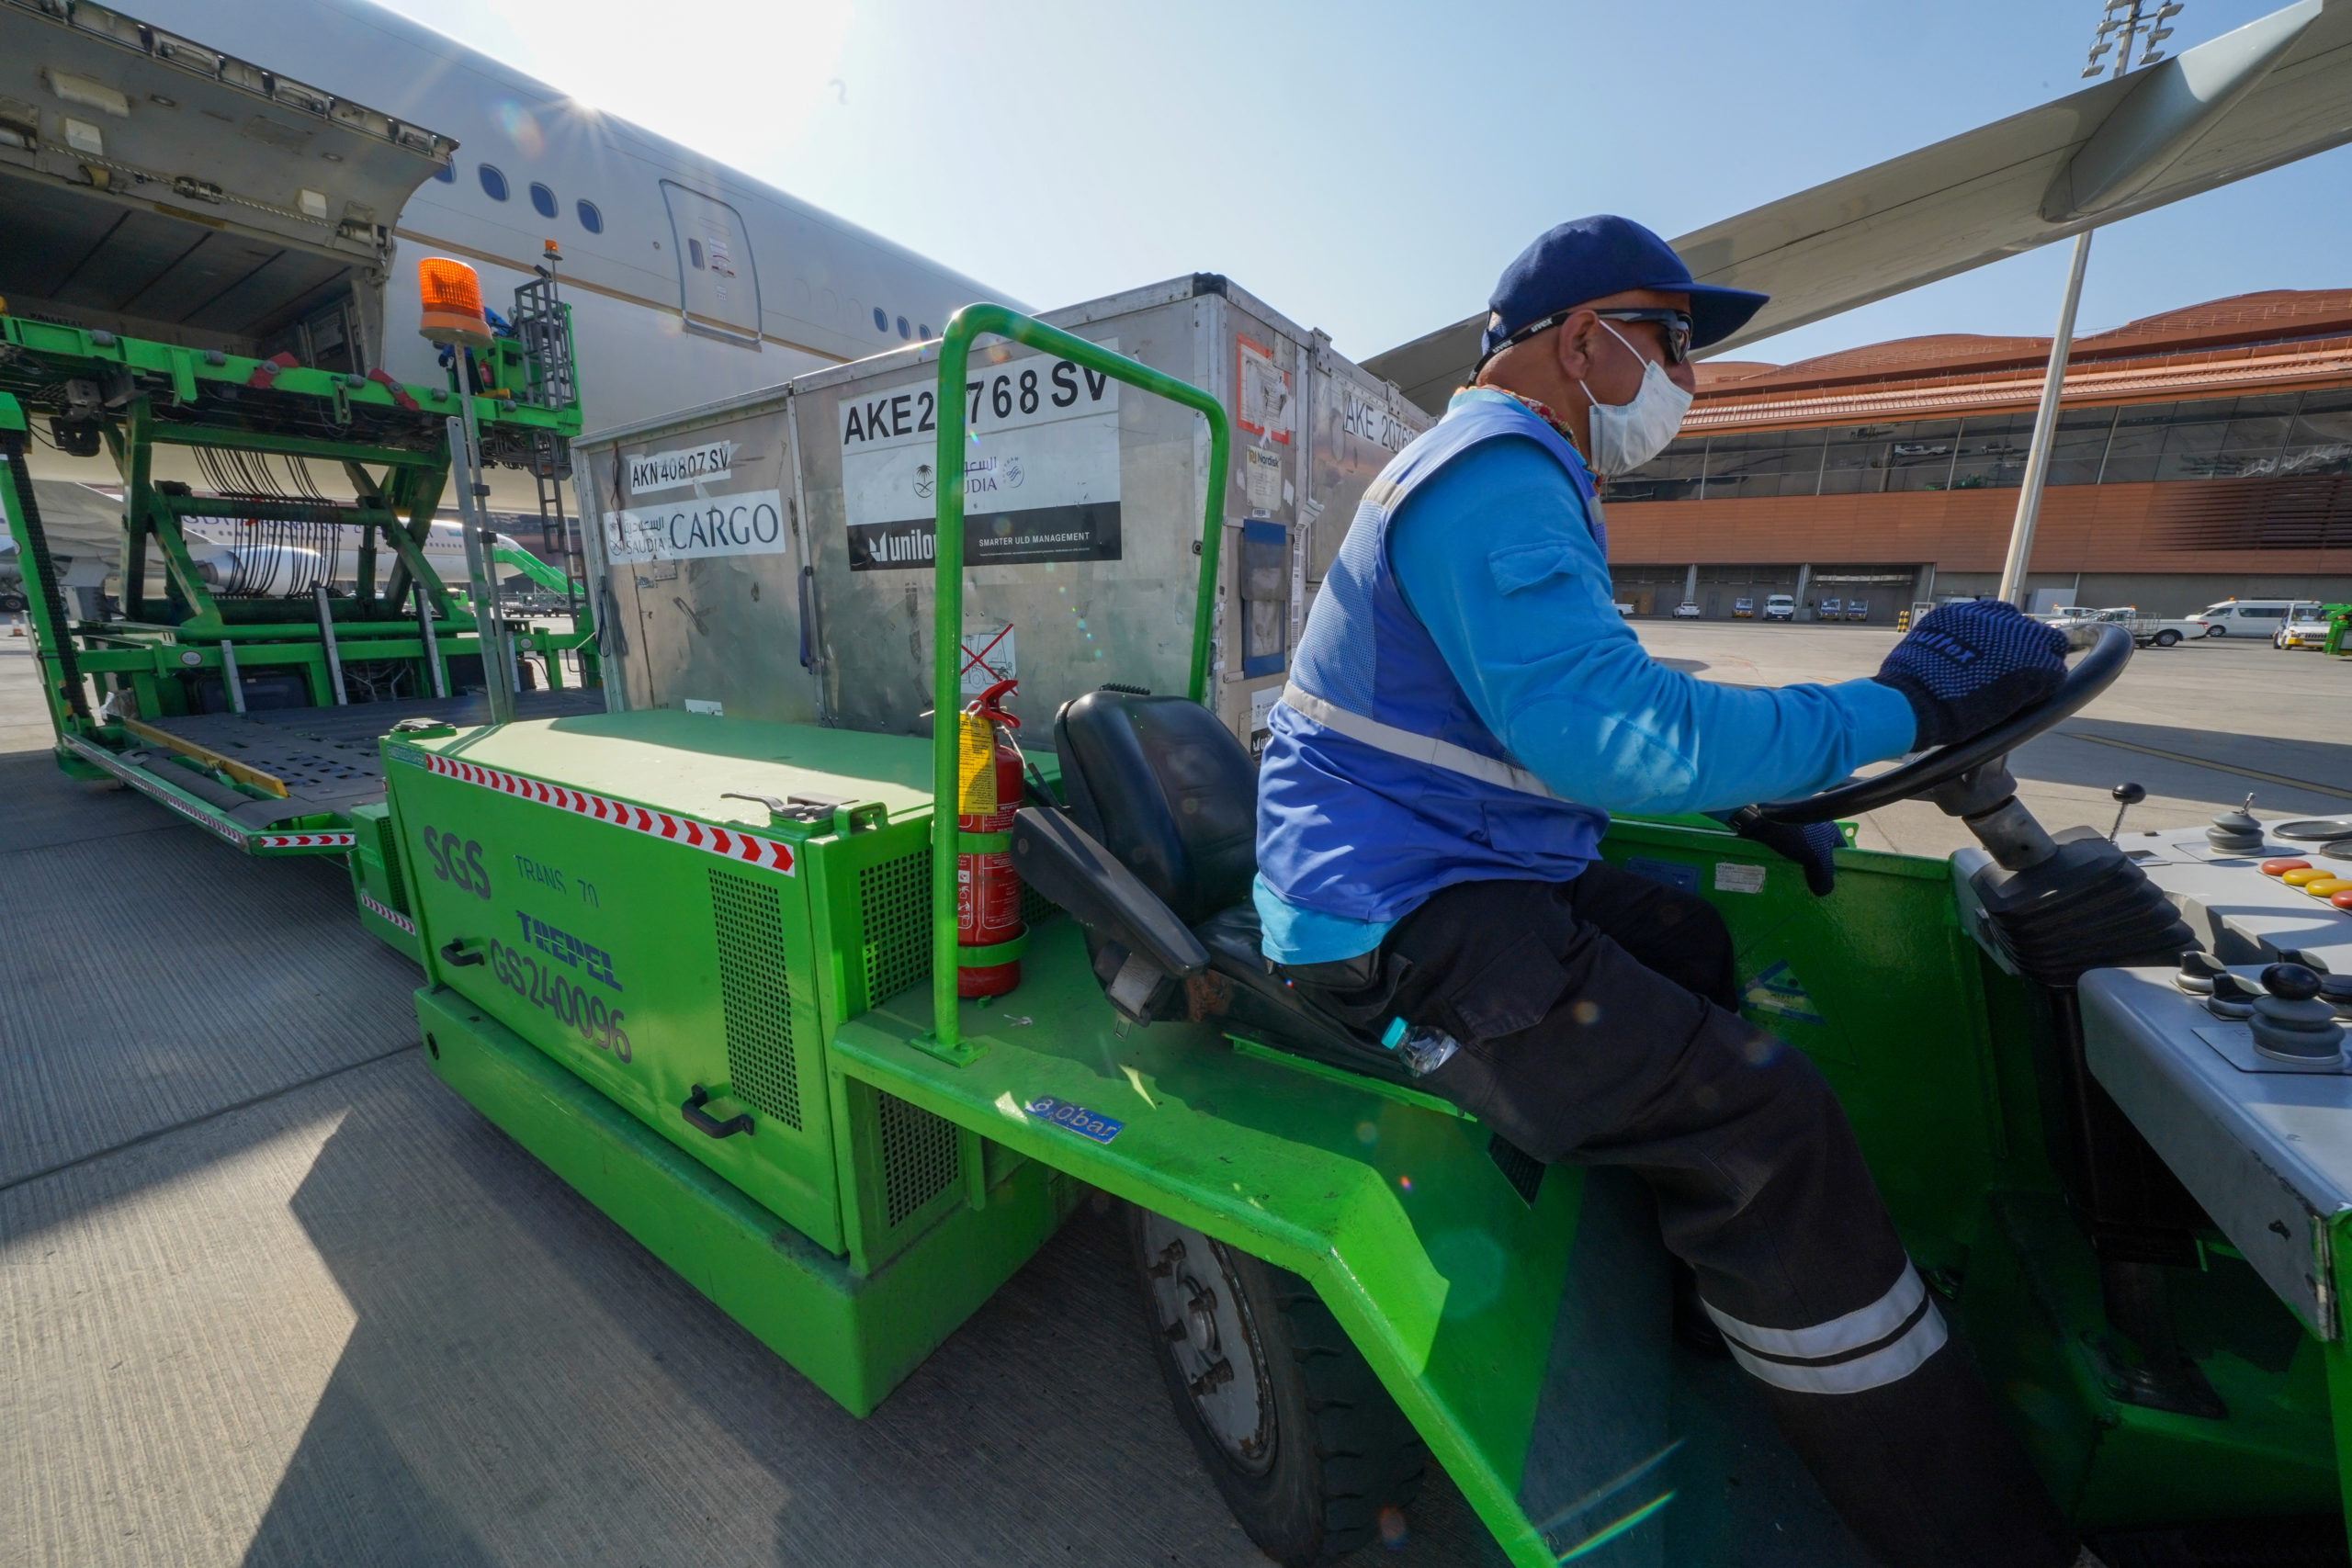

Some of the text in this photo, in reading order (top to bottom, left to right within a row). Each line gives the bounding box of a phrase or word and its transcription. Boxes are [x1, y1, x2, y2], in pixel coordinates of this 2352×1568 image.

[1531, 317, 1553, 333] uvex
[1345, 394, 1374, 441] AKE
[632, 461, 659, 489] AKN
[709, 447, 729, 472] SV
[626, 537, 665, 555] SAUDIA
[670, 503, 779, 550] CARGO
[888, 528, 936, 561] unilo
[978, 532, 1091, 547] SMARTER ULD MANAGEMENT
[424, 825, 492, 901] SGS
[514, 855, 567, 896] TRANS
[515, 909, 624, 993] TREPEL
[490, 937, 632, 1065] GS240096
